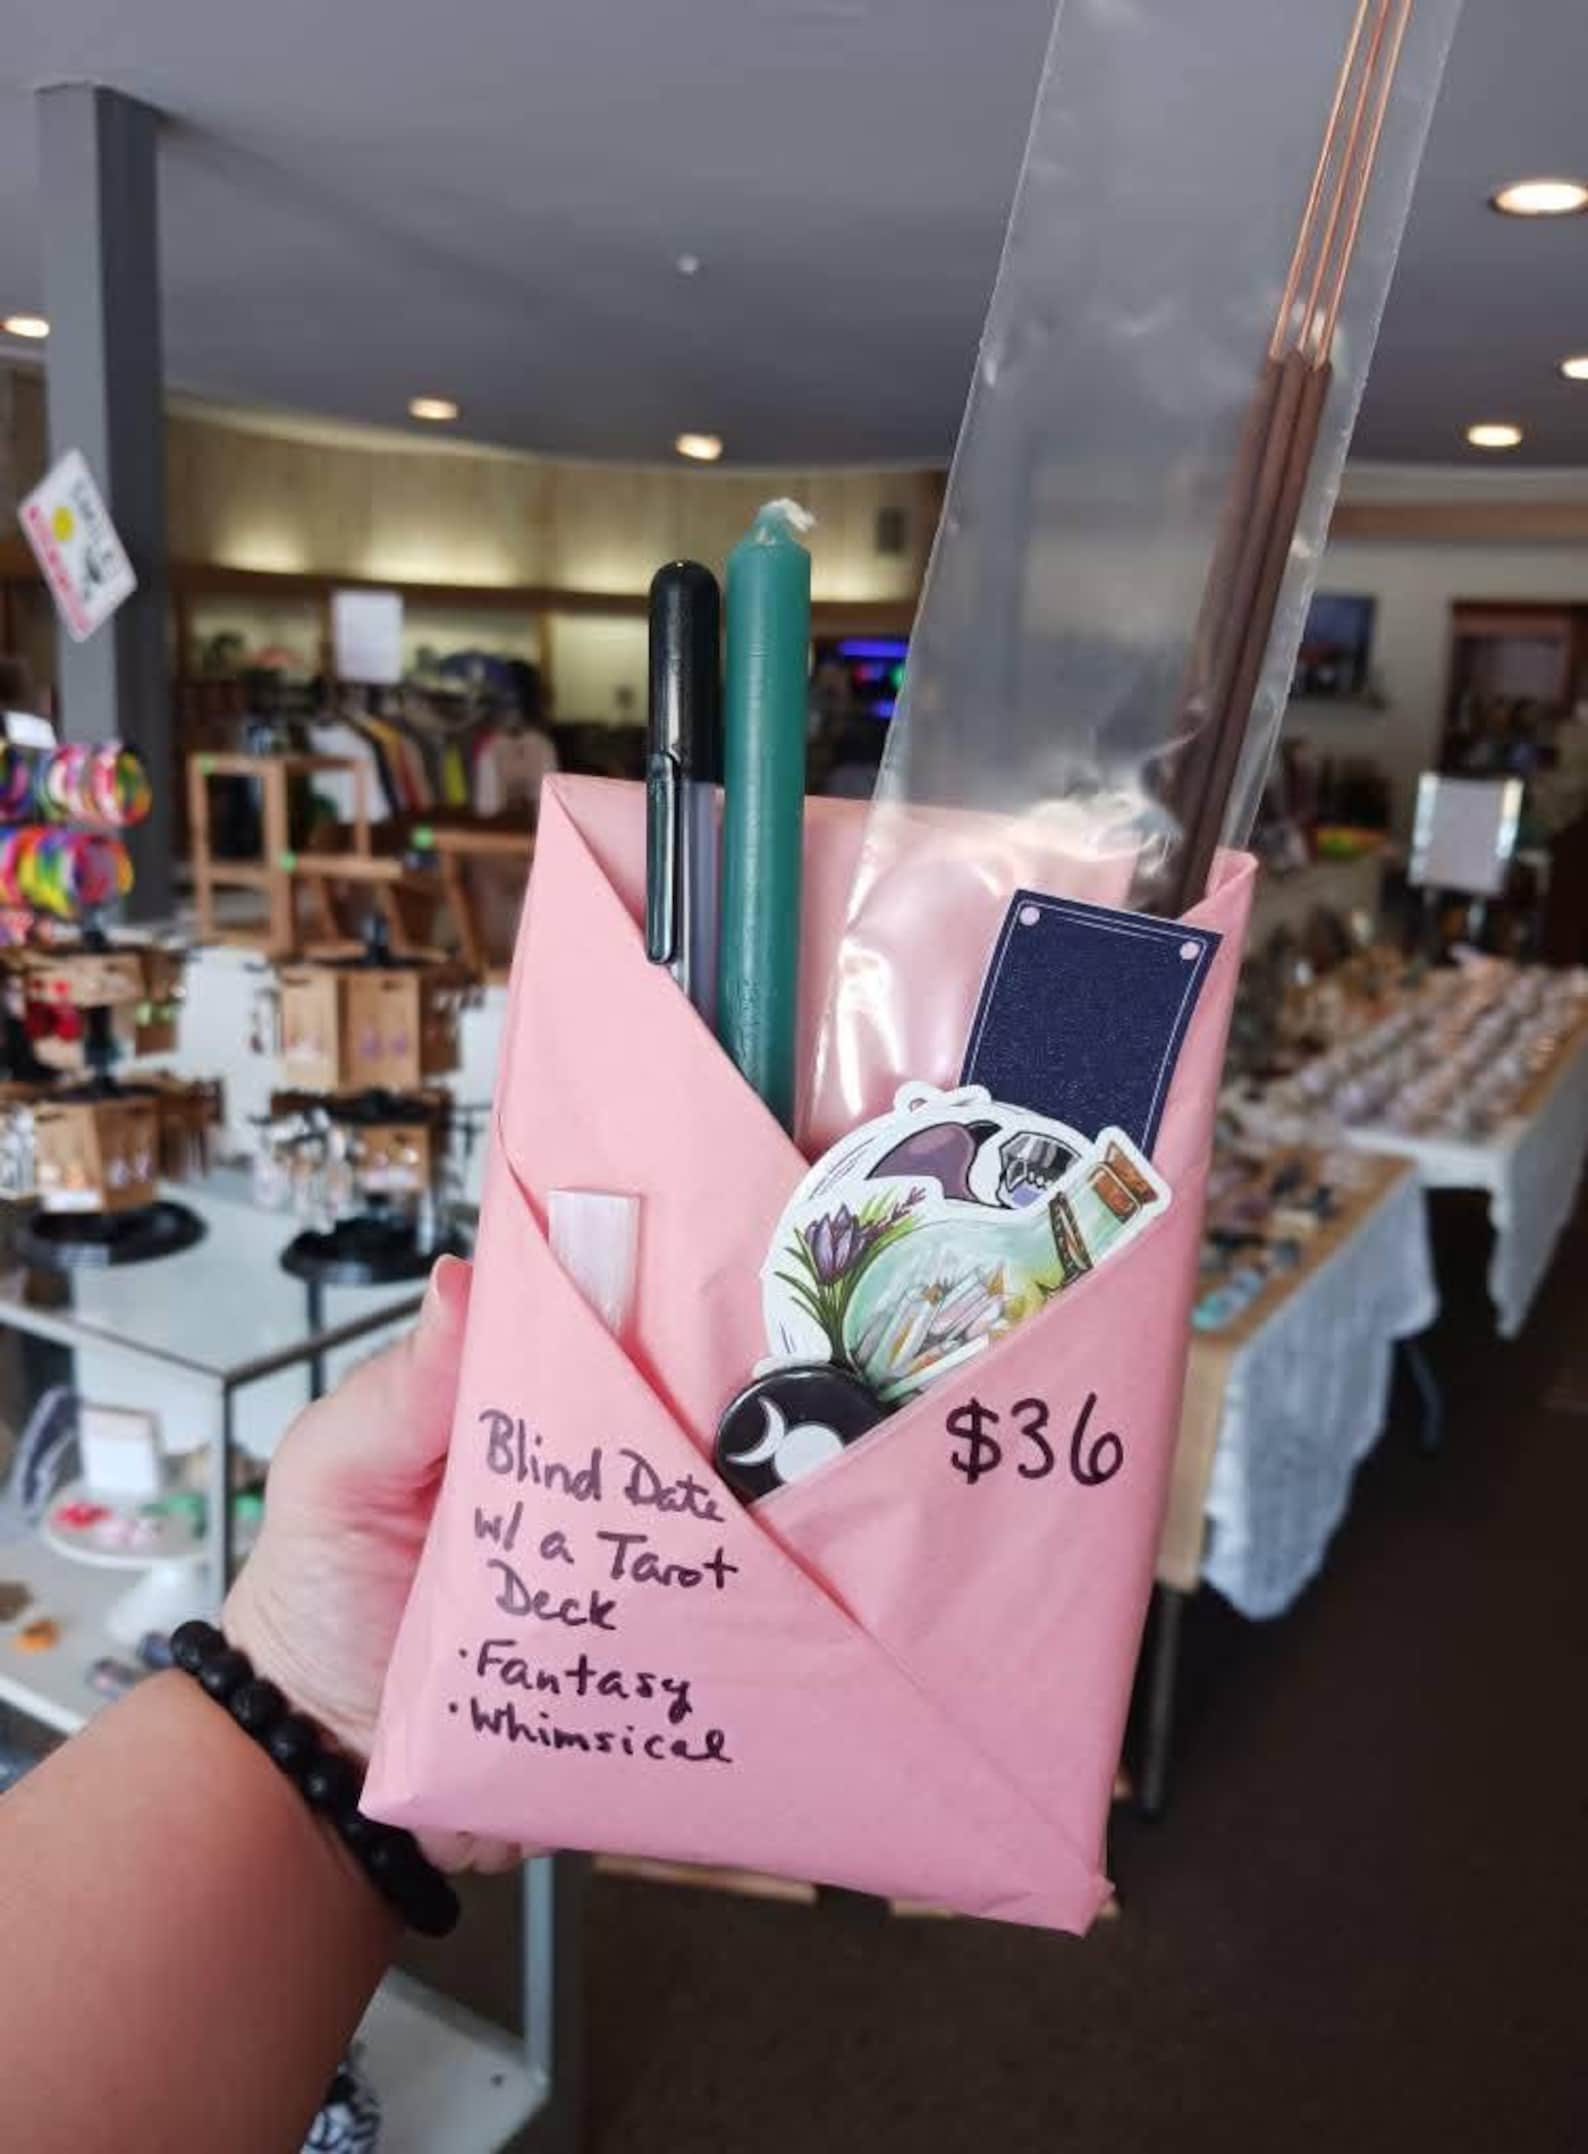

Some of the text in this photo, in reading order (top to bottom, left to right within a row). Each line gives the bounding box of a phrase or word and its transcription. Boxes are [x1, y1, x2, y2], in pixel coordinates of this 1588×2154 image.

[479, 1408, 725, 1523] Blind Date
[946, 1391, 1124, 1486] $36
[487, 1558, 616, 1631] Deck
[540, 1531, 576, 1565] a
[596, 1530, 739, 1590] Tarot
[476, 1638, 693, 1725] Fantasy
